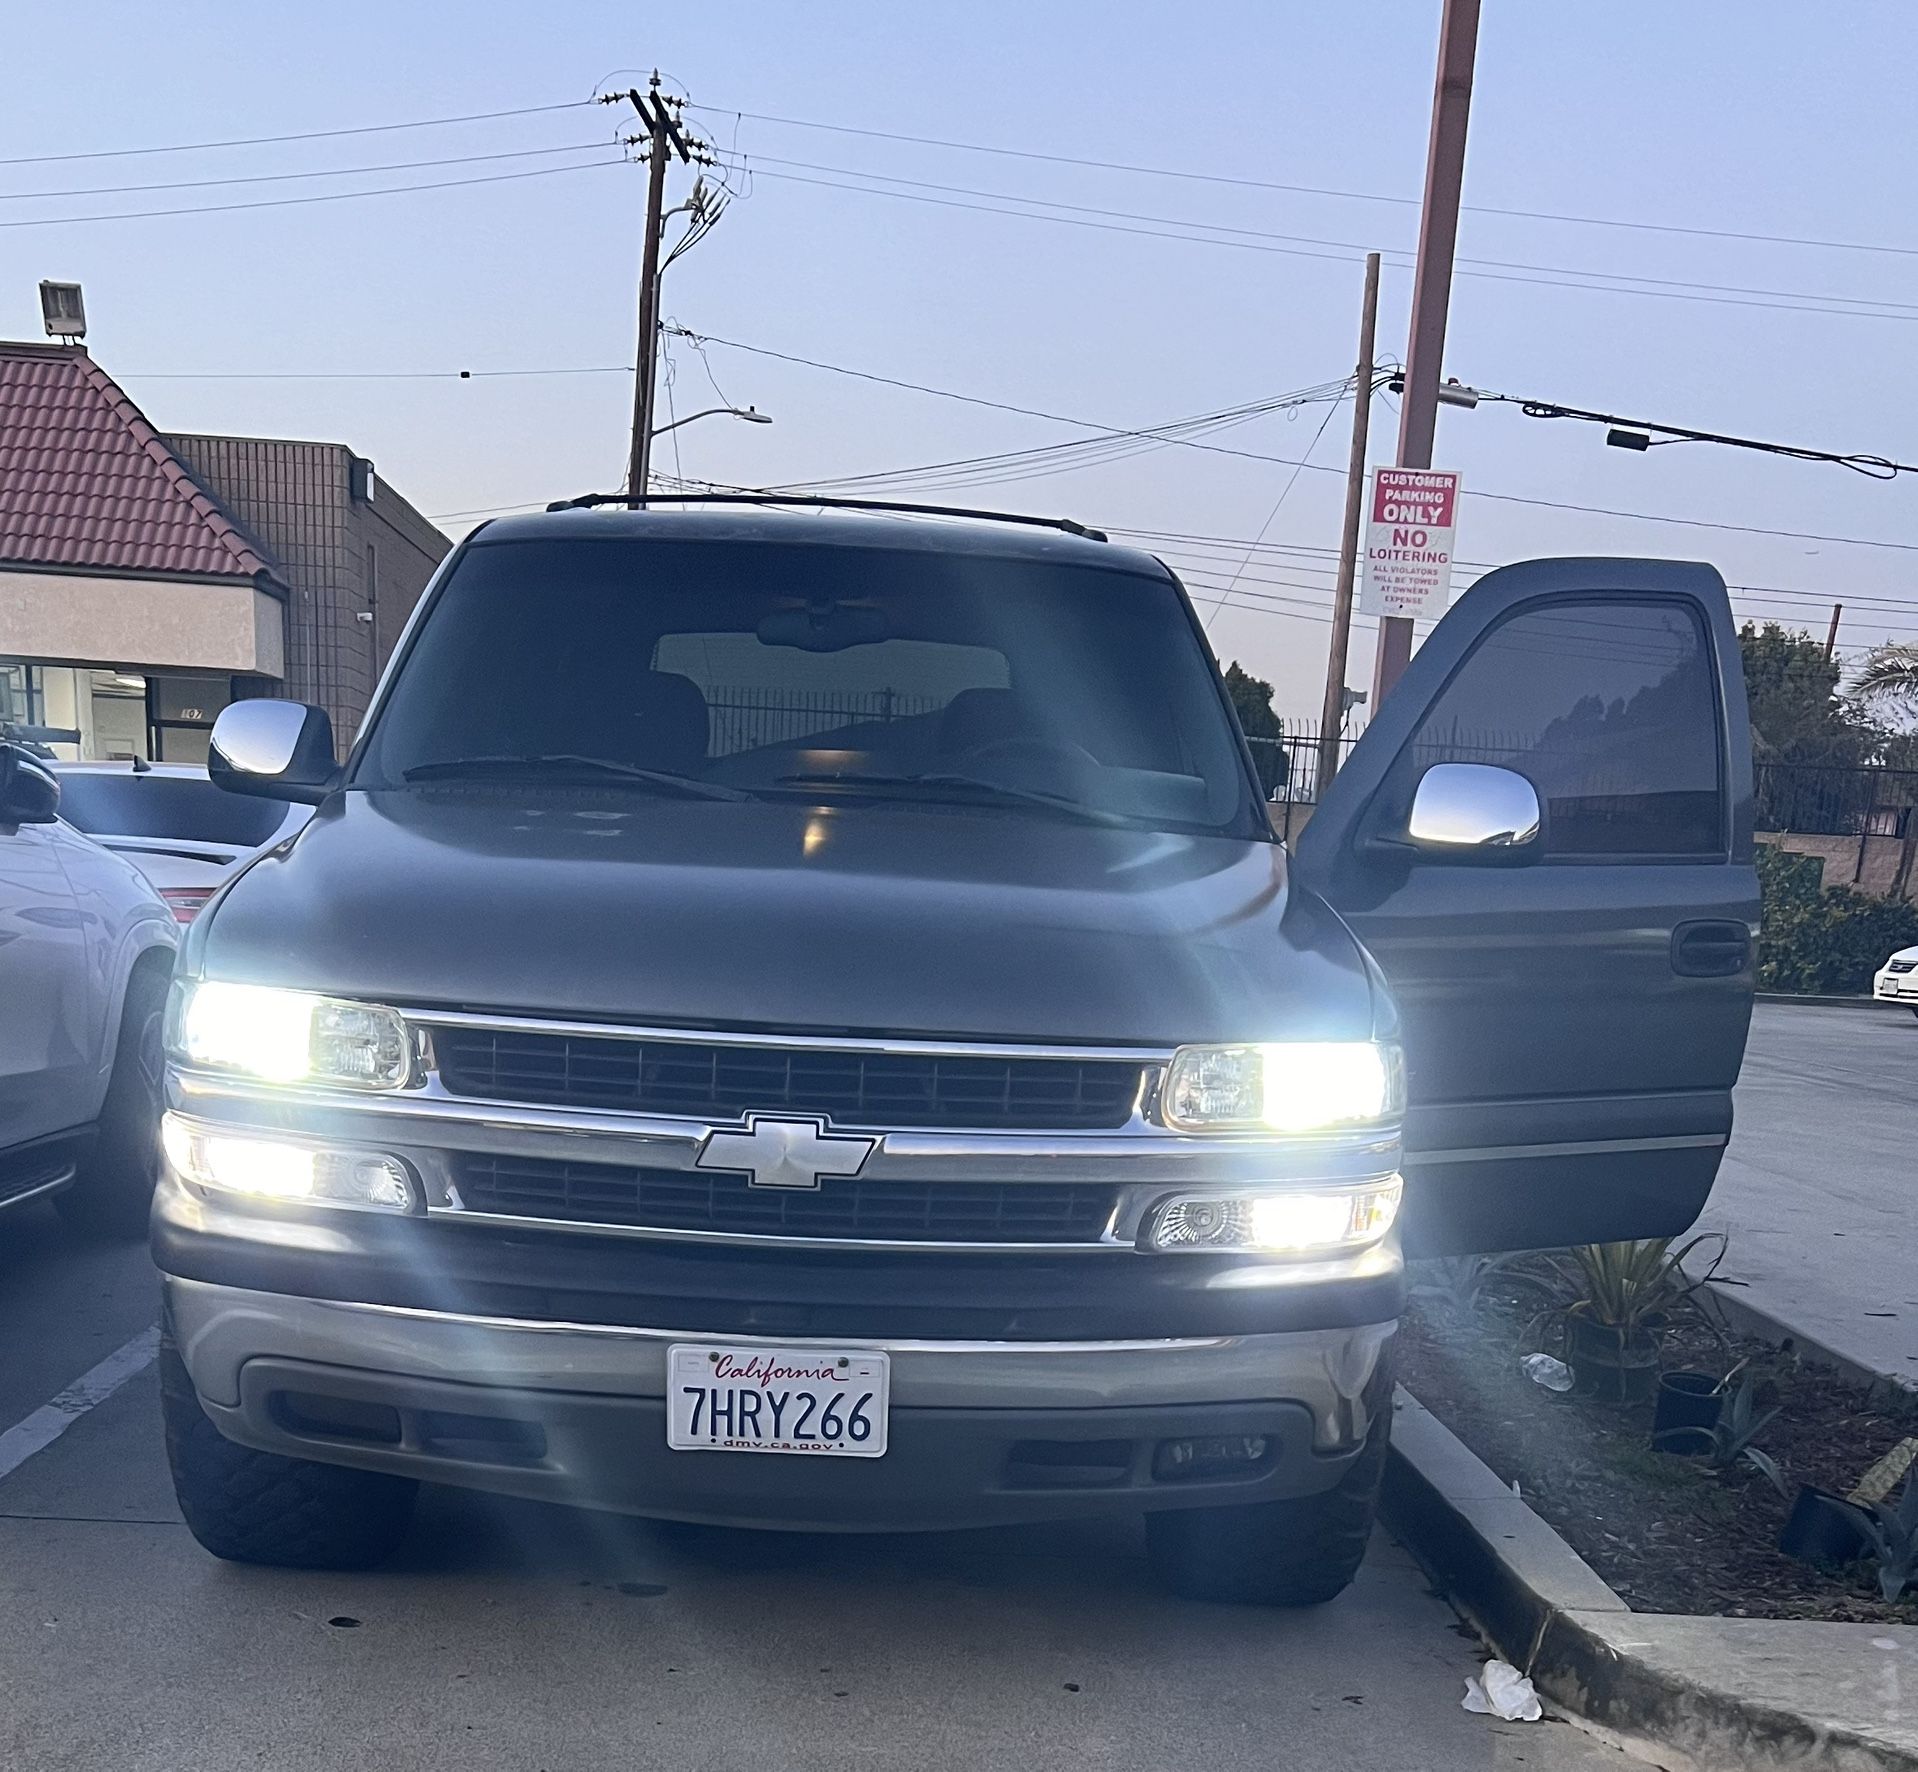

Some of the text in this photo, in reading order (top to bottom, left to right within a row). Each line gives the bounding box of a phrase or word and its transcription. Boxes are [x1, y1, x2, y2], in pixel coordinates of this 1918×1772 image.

[1380, 473, 1453, 489] CUSTOMER
[1385, 489, 1445, 503] PARKING
[1383, 503, 1443, 524] ONLY
[1392, 528, 1428, 548] NO
[1369, 547, 1448, 564] LOITERING
[1373, 565, 1439, 576] ALL VIOLATORS
[1373, 575, 1439, 586] WILL BE TOWED
[1392, 586, 1429, 595] OWNERS
[1384, 595, 1423, 604] EXPENSE
[715, 1354, 849, 1387] California
[683, 1386, 873, 1441] 7HRY266
[723, 1439, 833, 1450] dmv.ca.gov
